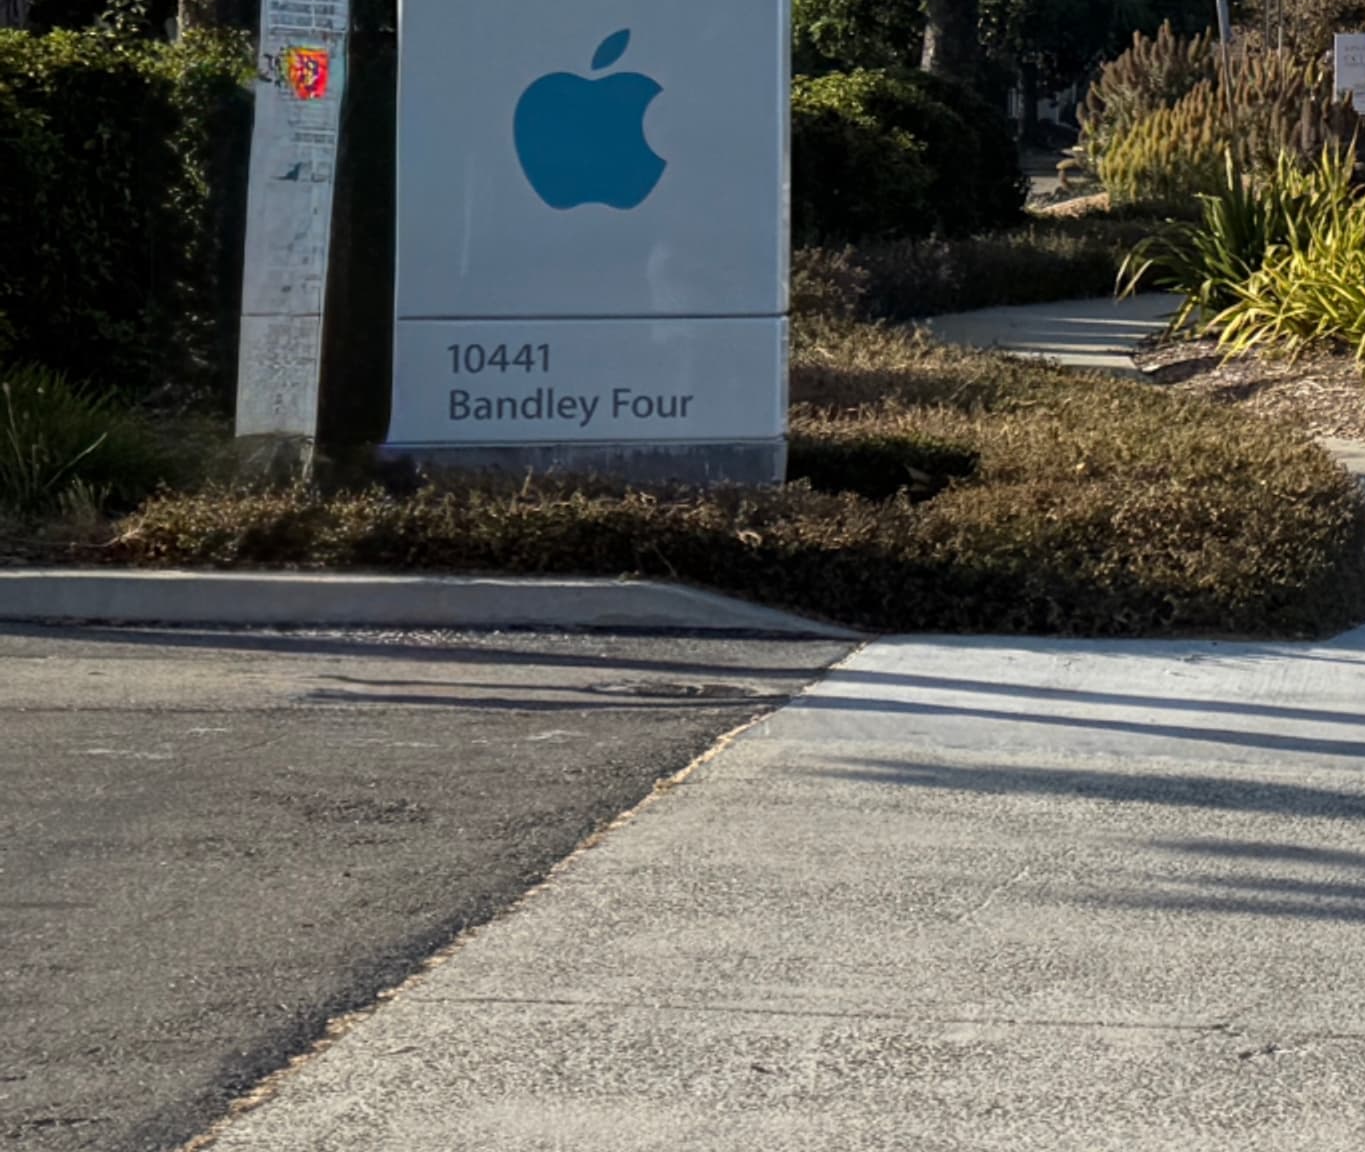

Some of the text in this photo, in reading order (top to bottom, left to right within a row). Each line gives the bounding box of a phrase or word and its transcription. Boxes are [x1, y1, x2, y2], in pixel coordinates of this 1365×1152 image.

[447, 343, 550, 373] 10441
[449, 387, 694, 427] Bandley Four
